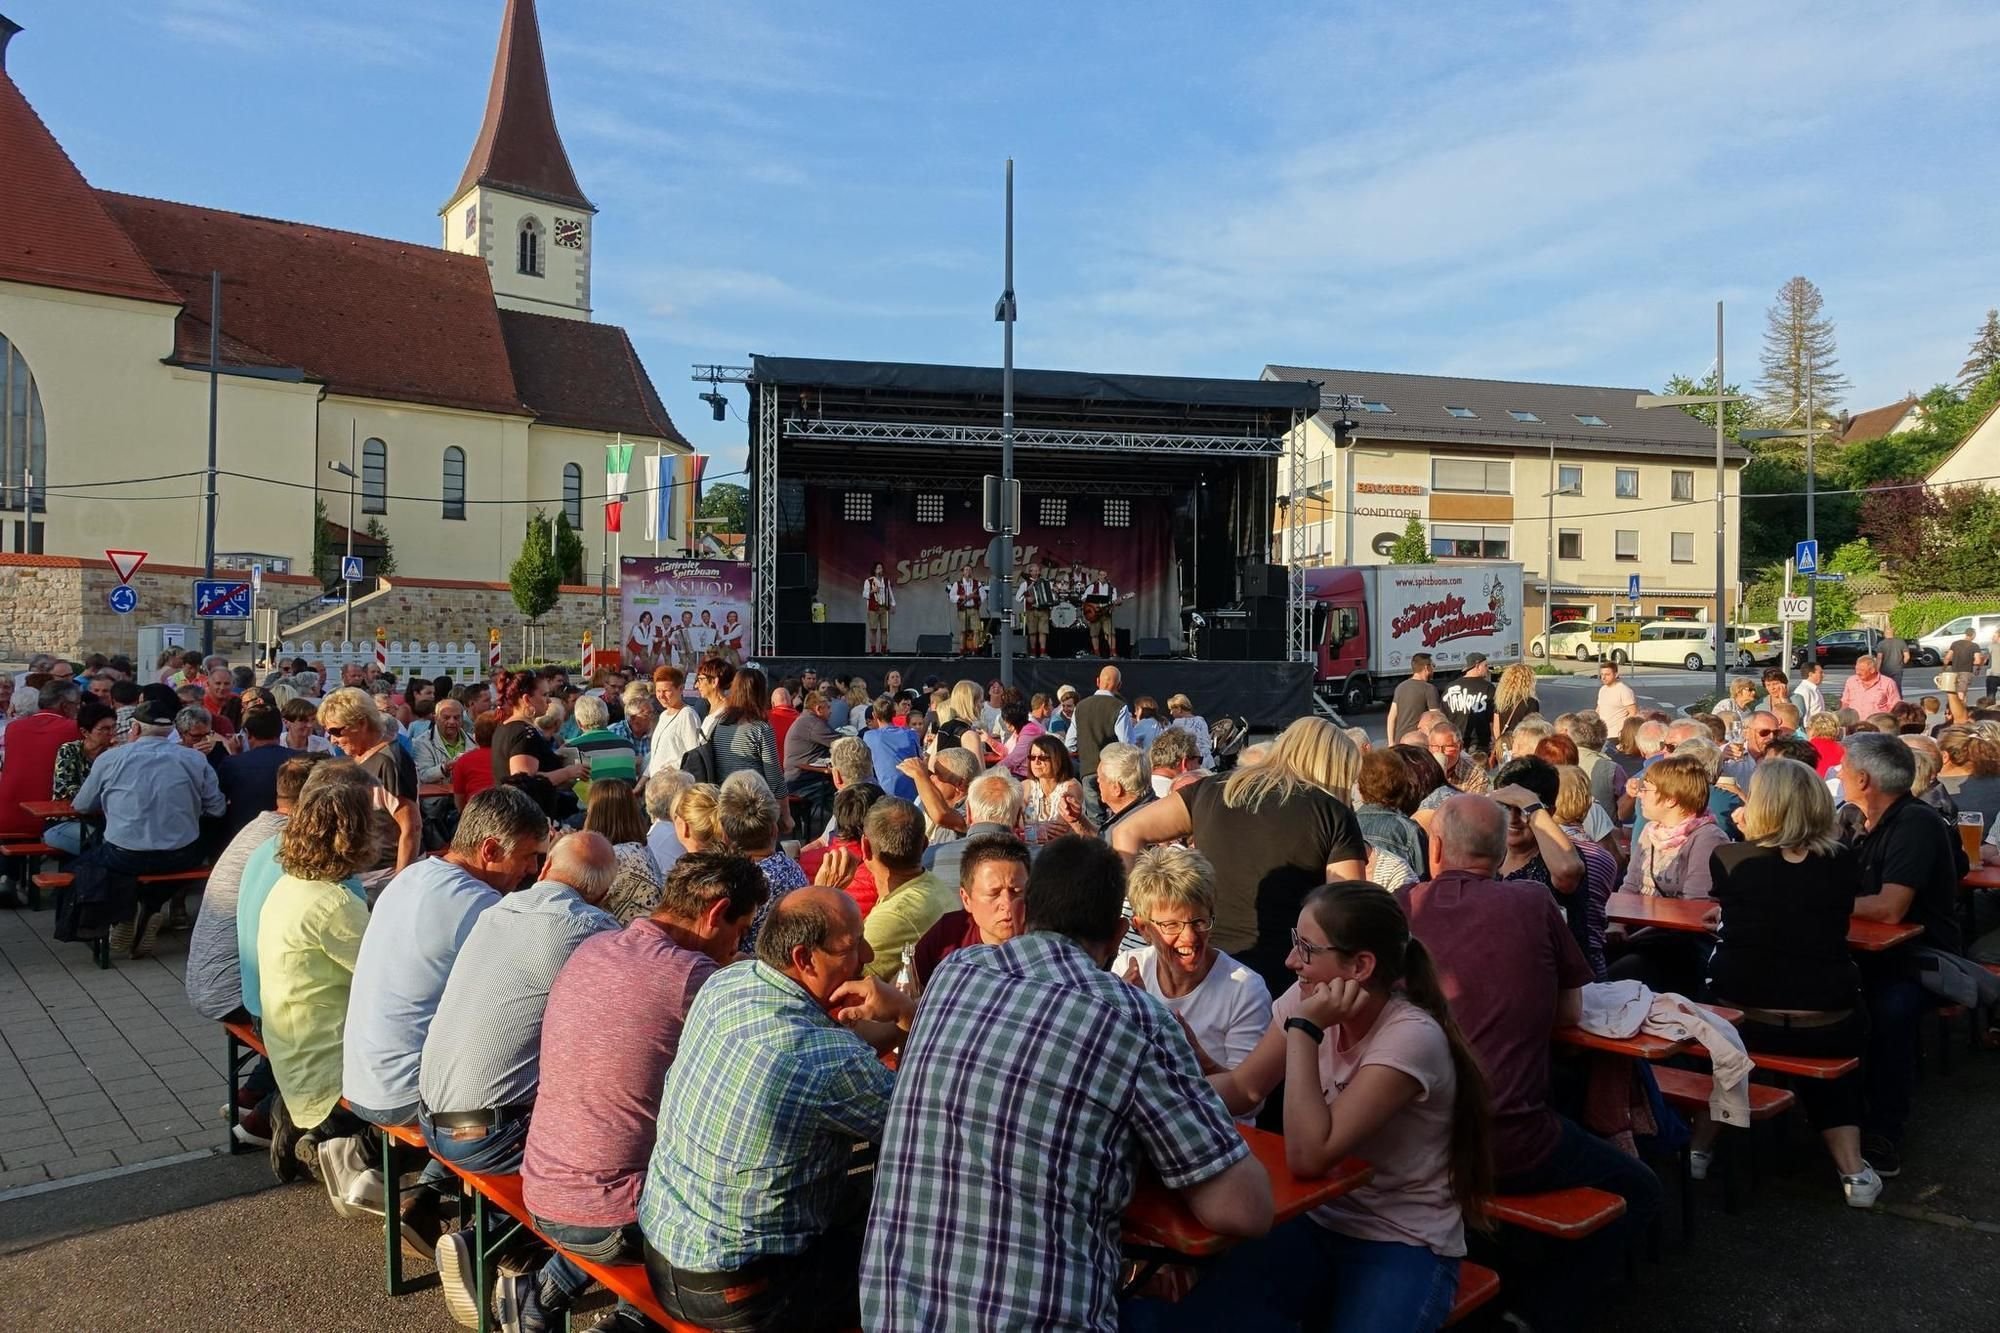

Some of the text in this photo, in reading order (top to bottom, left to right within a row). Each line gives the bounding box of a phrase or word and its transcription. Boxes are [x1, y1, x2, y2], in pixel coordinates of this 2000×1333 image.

[1354, 507, 1422, 519] KONDITOREI
[640, 579, 734, 596] FANSHOP
[1783, 599, 1808, 613] WC
